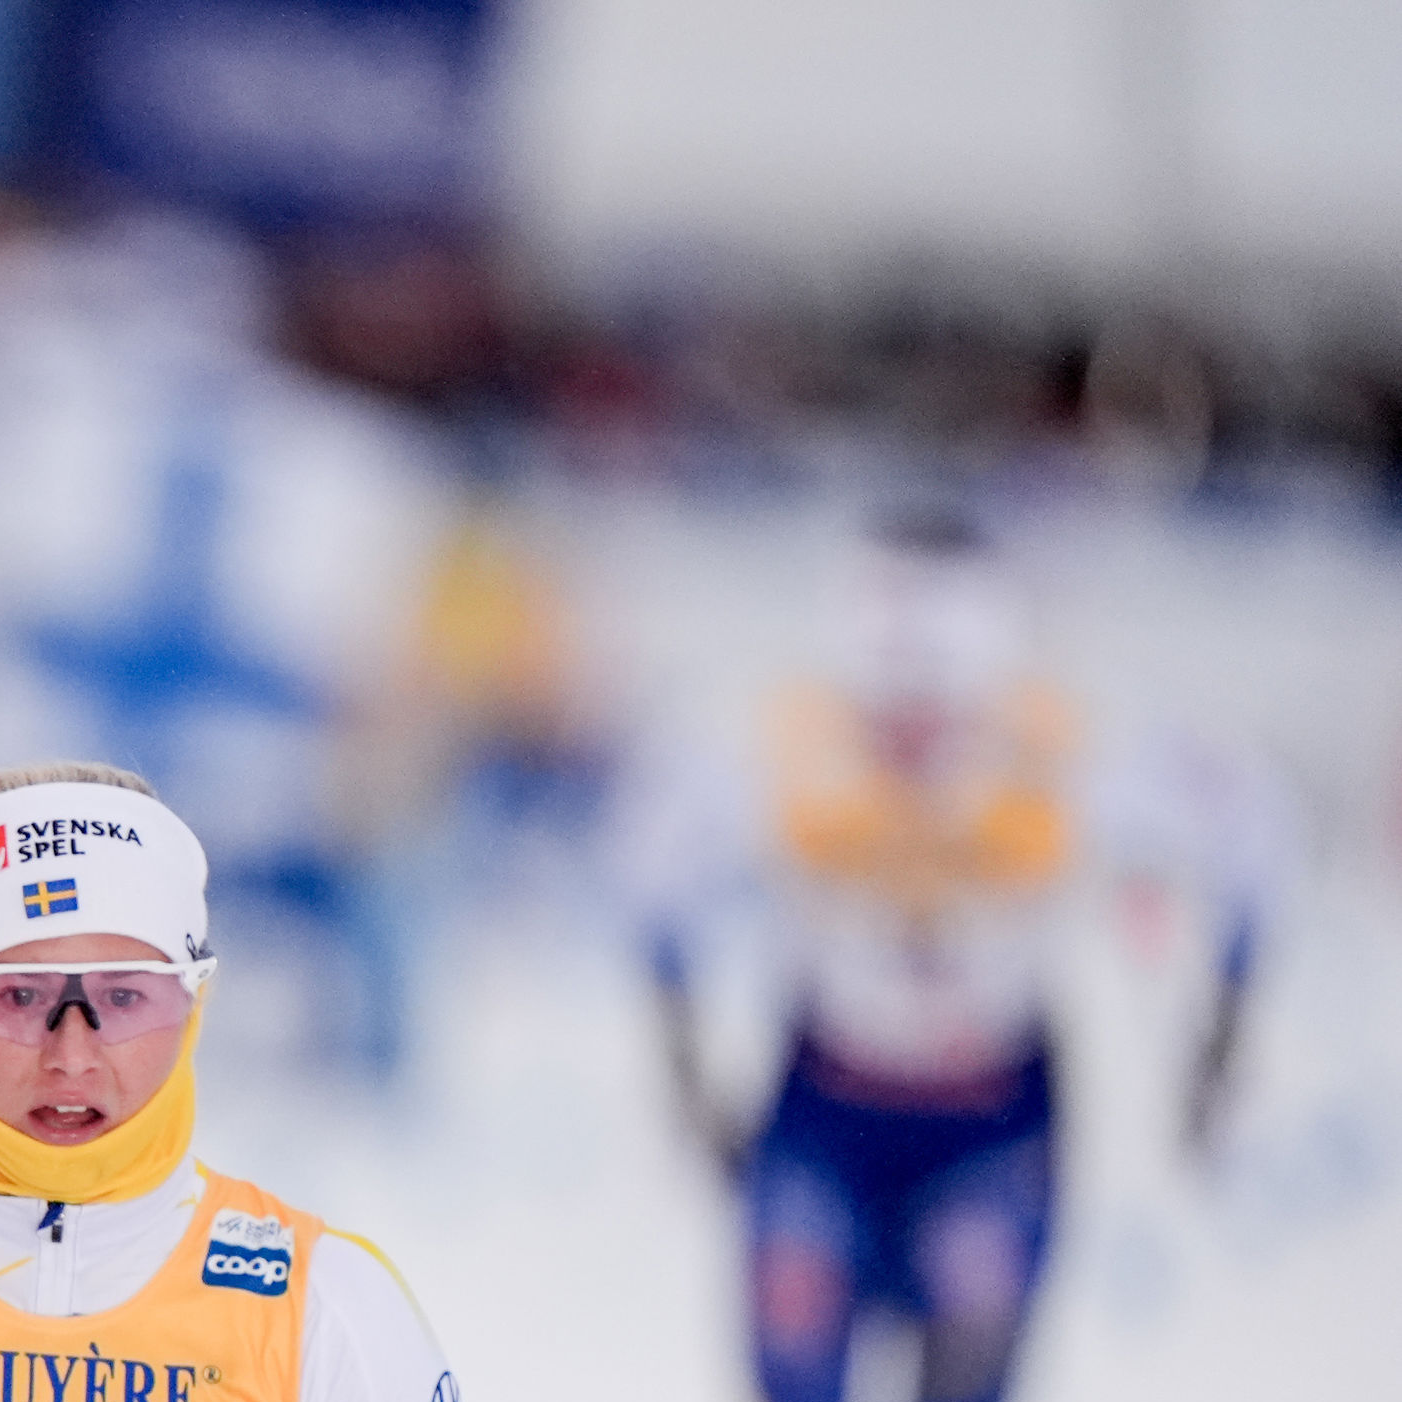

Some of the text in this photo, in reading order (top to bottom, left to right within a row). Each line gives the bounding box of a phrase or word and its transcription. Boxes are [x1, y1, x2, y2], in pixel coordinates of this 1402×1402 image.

[16, 818, 143, 847] SVENSKA
[18, 838, 86, 863] SPEL
[207, 1254, 288, 1286] coop
